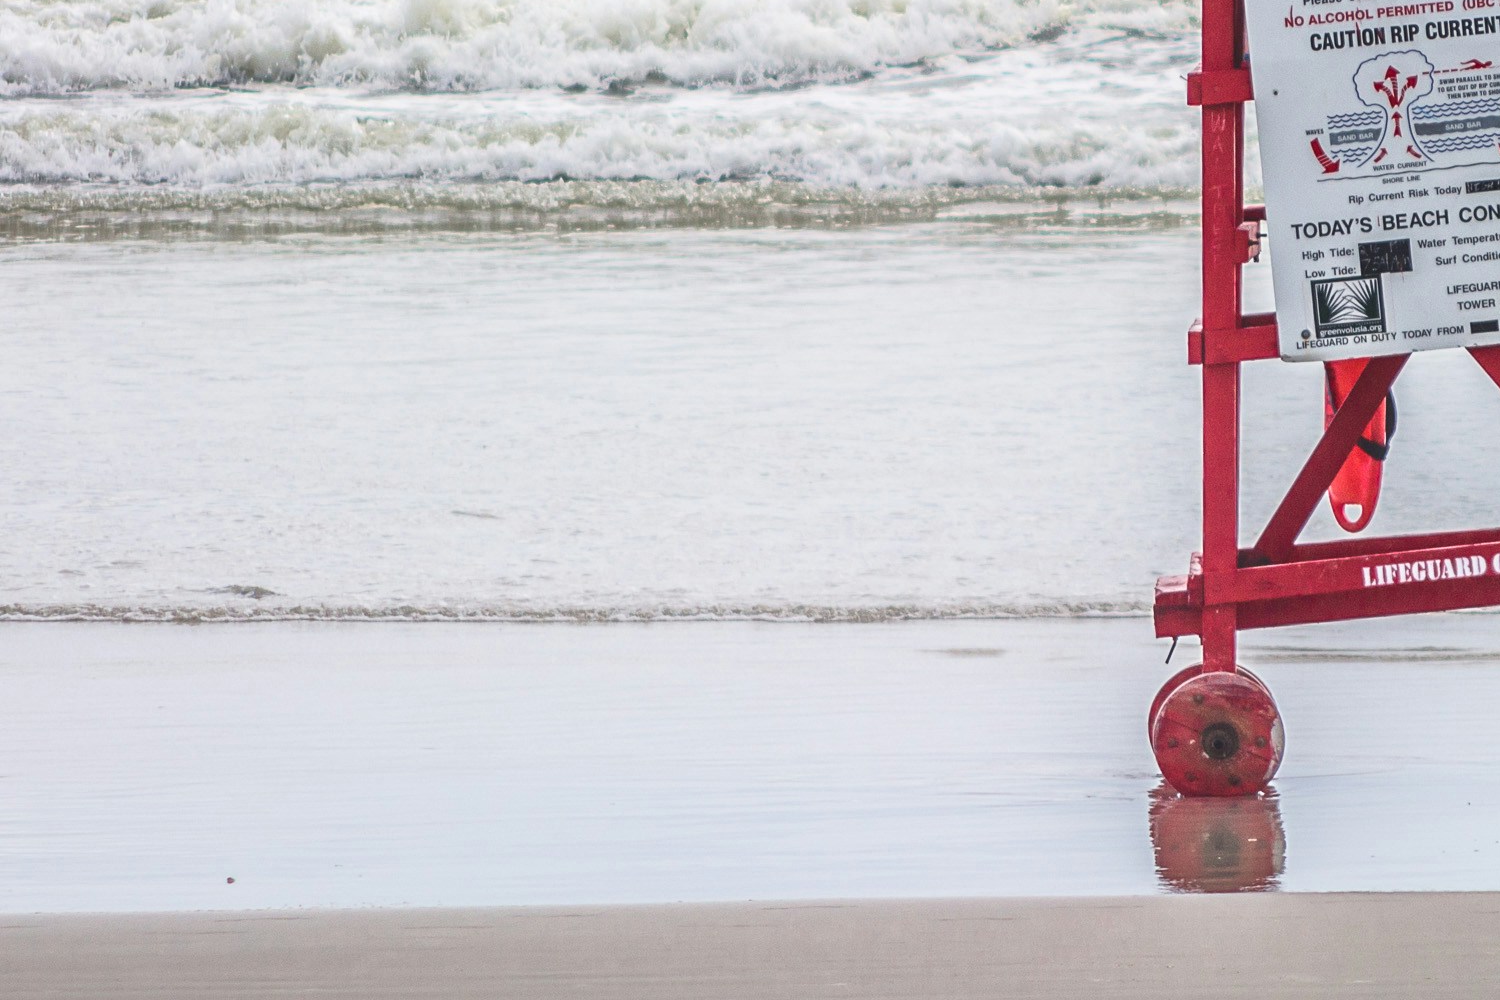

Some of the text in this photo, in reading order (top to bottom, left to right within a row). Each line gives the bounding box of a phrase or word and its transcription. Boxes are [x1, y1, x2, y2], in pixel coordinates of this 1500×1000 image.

[1284, 15, 1304, 28] NO
[1308, 9, 1374, 25] ALCOHOL
[1377, 1, 1454, 18] PERMITTED
[1310, 27, 1386, 51] CAUTION
[1390, 24, 1420, 43] RIP
[1456, 75, 1482, 84] PARALLEL
[1445, 120, 1482, 130] SAND BAR
[1338, 134, 1356, 142] SAND
[1397, 161, 1428, 170] CURRENT
[1382, 176, 1404, 184] SHORE
[1348, 194, 1364, 205] Rip
[1368, 191, 1404, 202] Current
[1408, 189, 1430, 198] Risk
[1434, 186, 1462, 196] Today
[1291, 217, 1373, 240] TODAY'S
[1382, 209, 1450, 231] BEACH
[1418, 238, 1446, 248] Water
[1302, 248, 1354, 261] High Tide:
[1436, 255, 1457, 266] Surf
[1305, 266, 1356, 278] Low Tide:
[1457, 298, 1496, 310] TOWER
[1320, 324, 1382, 338] greenvolusia.org
[1296, 326, 1465, 350] LIFEGUARD ON DUTY TODAY FROM
[1362, 555, 1488, 588] LIFEGUARD
